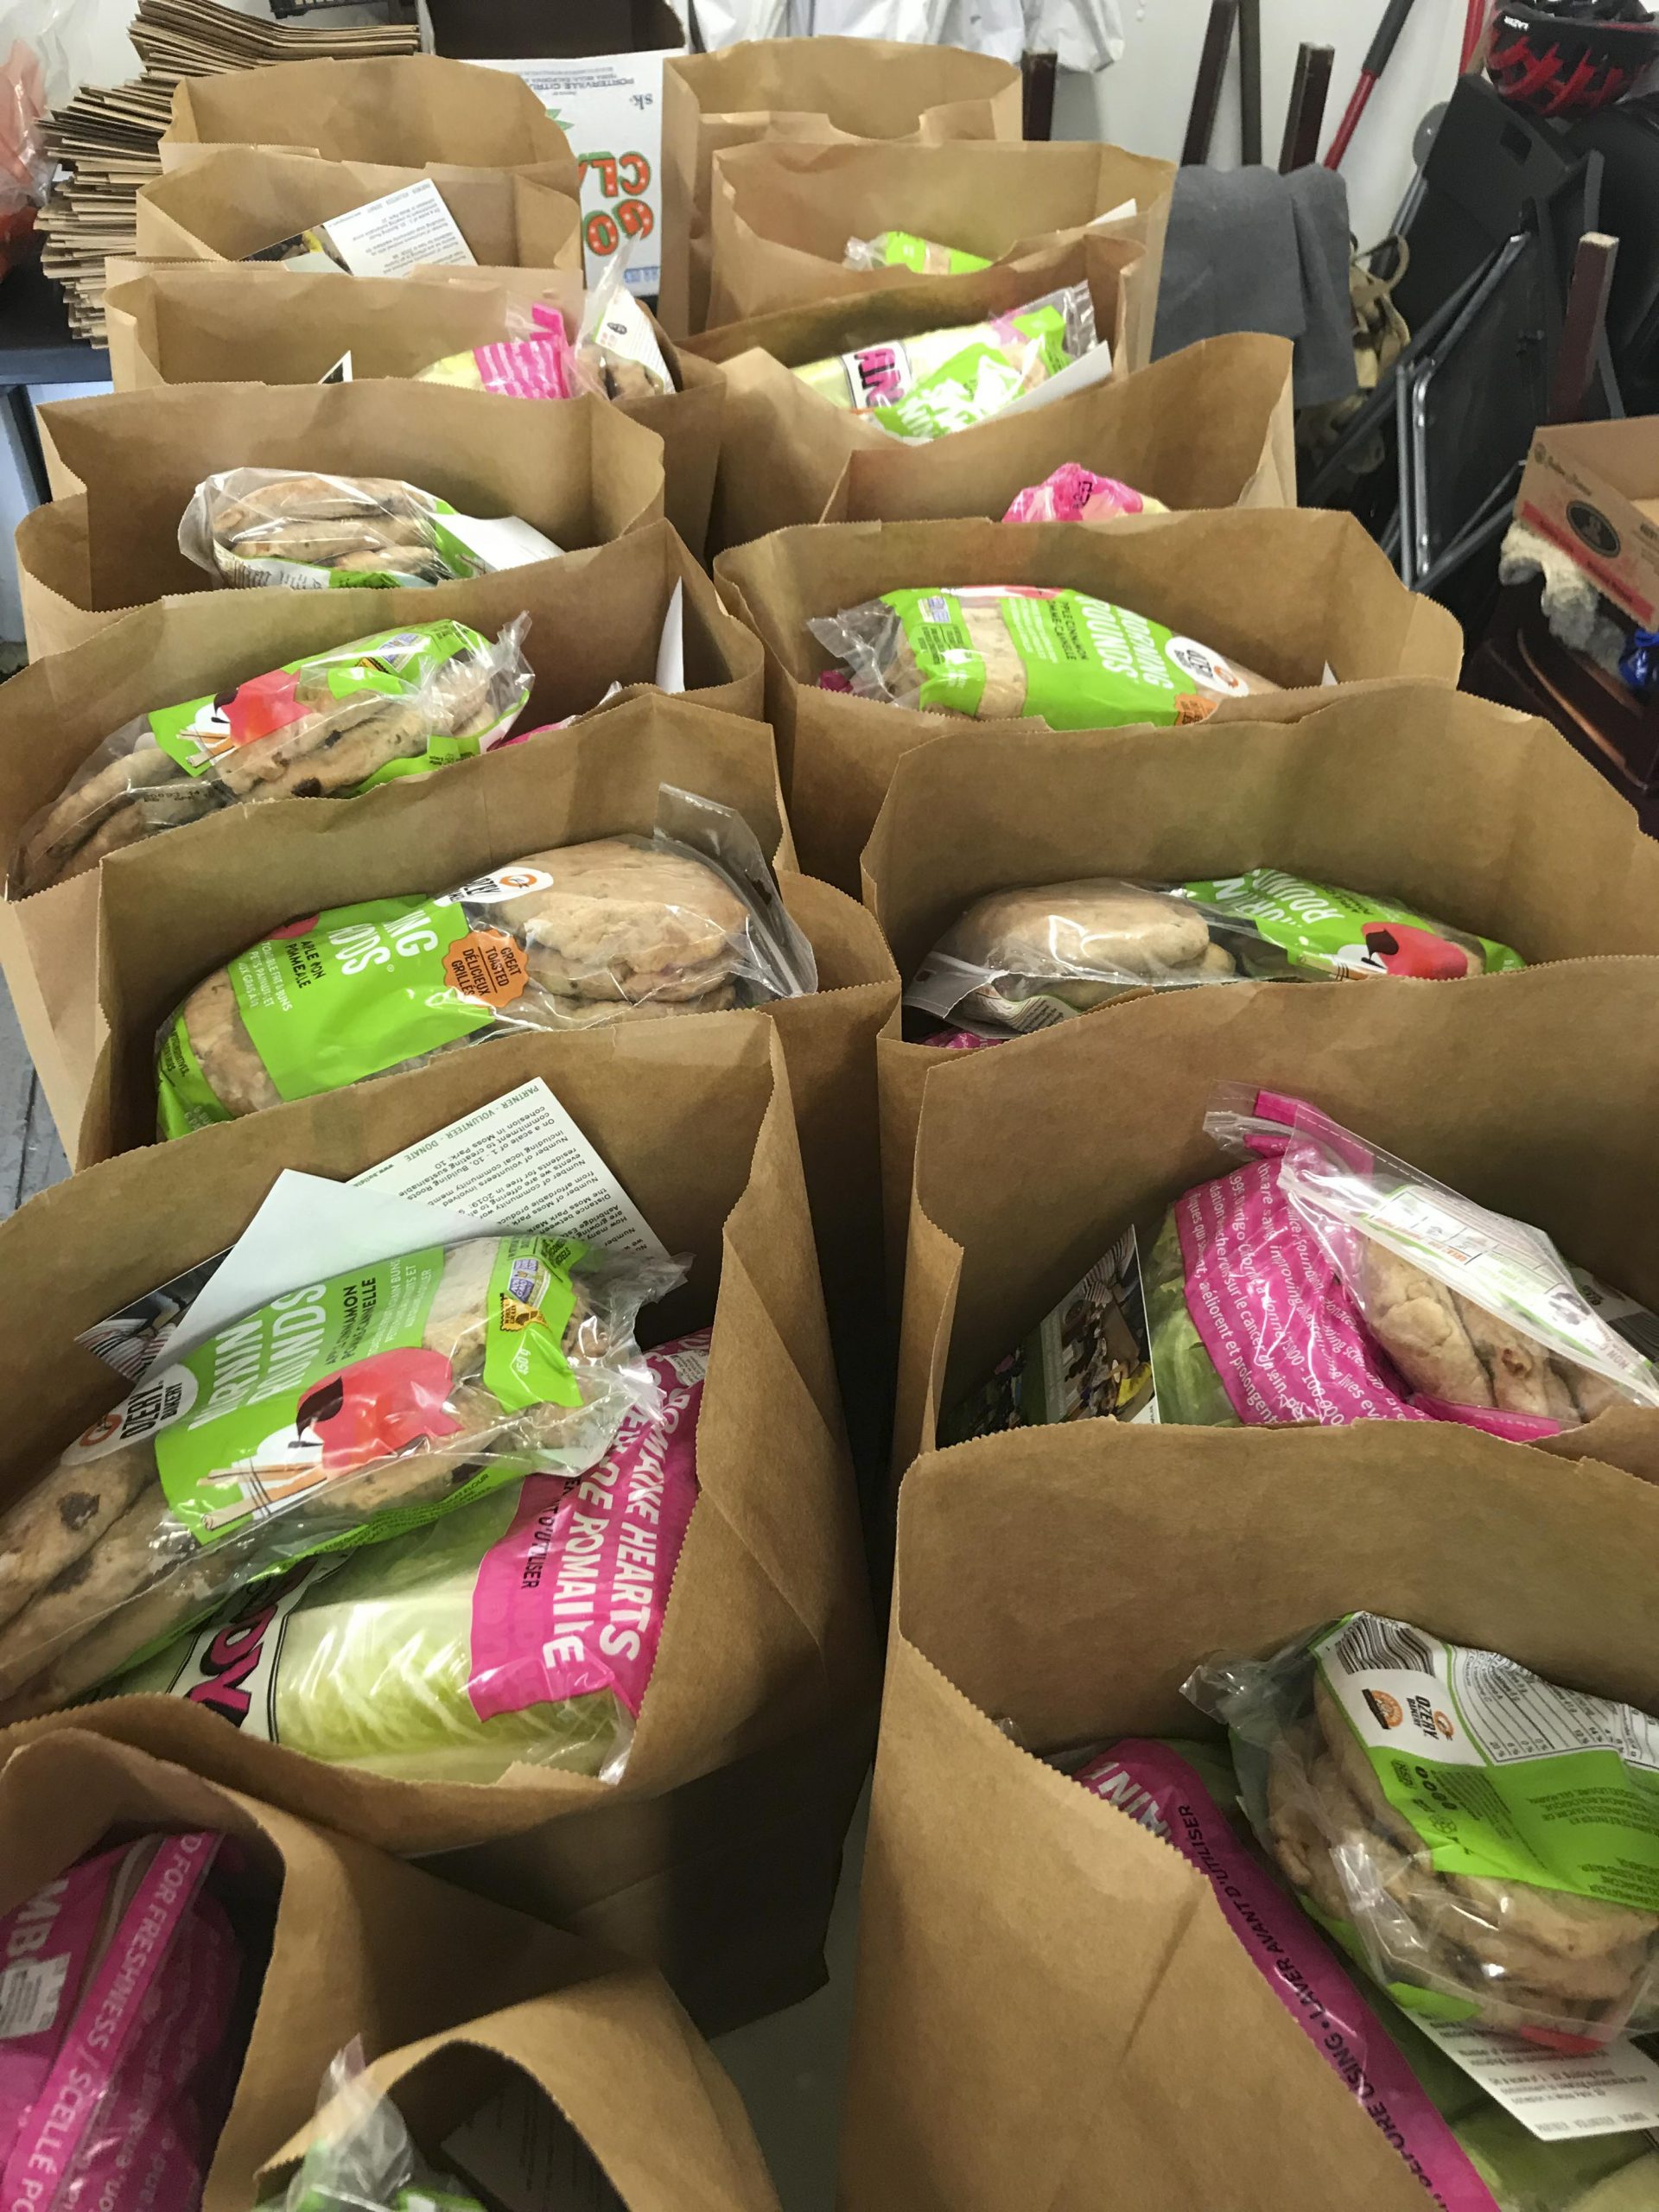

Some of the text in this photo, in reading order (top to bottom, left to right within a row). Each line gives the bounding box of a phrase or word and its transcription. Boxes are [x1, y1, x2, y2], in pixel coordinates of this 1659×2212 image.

[463, 949, 491, 996] DÉLICIEUX
[485, 946, 509, 987] TOASTED
[500, 947, 521, 976] GREAT
[500, 1084, 538, 1109] PARTNER
[445, 1108, 494, 1140] VOLUNTEER
[506, 1105, 545, 1130] cohesion
[542, 1117, 555, 1128] On
[471, 1133, 495, 1149] Moss
[496, 1127, 505, 1135] in
[510, 1128, 533, 1145] scale
[524, 1128, 563, 1154] including
[397, 1111, 550, 1198] commitment to creating sustainable
[403, 1139, 438, 1162] DONATE
[499, 1142, 509, 1151] of
[502, 1151, 524, 1166] local
[434, 1160, 446, 1169] 10
[442, 1135, 568, 1207] Number of volunteers involved
[537, 1146, 576, 1172] residents
[552, 1152, 581, 1171] events
[552, 1158, 585, 1179] Number
[432, 1163, 468, 1187] Building
[454, 1161, 501, 1192] community
[505, 1176, 523, 1189] free
[523, 1176, 537, 1186] are
[524, 1168, 536, 1179] for
[538, 1168, 551, 1178] we
[541, 1177, 551, 1185] of
[574, 1169, 594, 1184] from
[488, 1183, 523, 1205] offering
[494, 1181, 540, 1211] community
[531, 1181, 573, 1207] affordable
[565, 1175, 598, 1197] Number
[592, 1187, 607, 1198] the
[479, 1203, 489, 1211] to
[531, 1199, 554, 1215] Moss
[539, 1192, 611, 1235] Distance between
[549, 1208, 568, 1222] Park
[569, 1195, 591, 1211] Moss
[511, 1212, 531, 1226] Park
[576, 1210, 622, 1238] are growing
[578, 1203, 619, 1230] Ashbridge
[586, 1215, 627, 1241] How many
[603, 1226, 635, 1247] Number
[1234, 1296, 1247, 1310] le
[1240, 1310, 1264, 1351] cancer
[1225, 1339, 1238, 1356] et
[1230, 1357, 1277, 1424] prolongent
[599, 1522, 657, 1662] HEARTS
[1415, 1694, 1439, 1739] OZERY
[1178, 1804, 1242, 1898] D'UTILISER
[154, 1856, 192, 1904] FOR
[1233, 1900, 1285, 1954] AVANT
[87, 1904, 168, 2051] FRESHNESS
[1275, 1958, 1325, 2019] LAVER
[1324, 2032, 1375, 2100] USING
